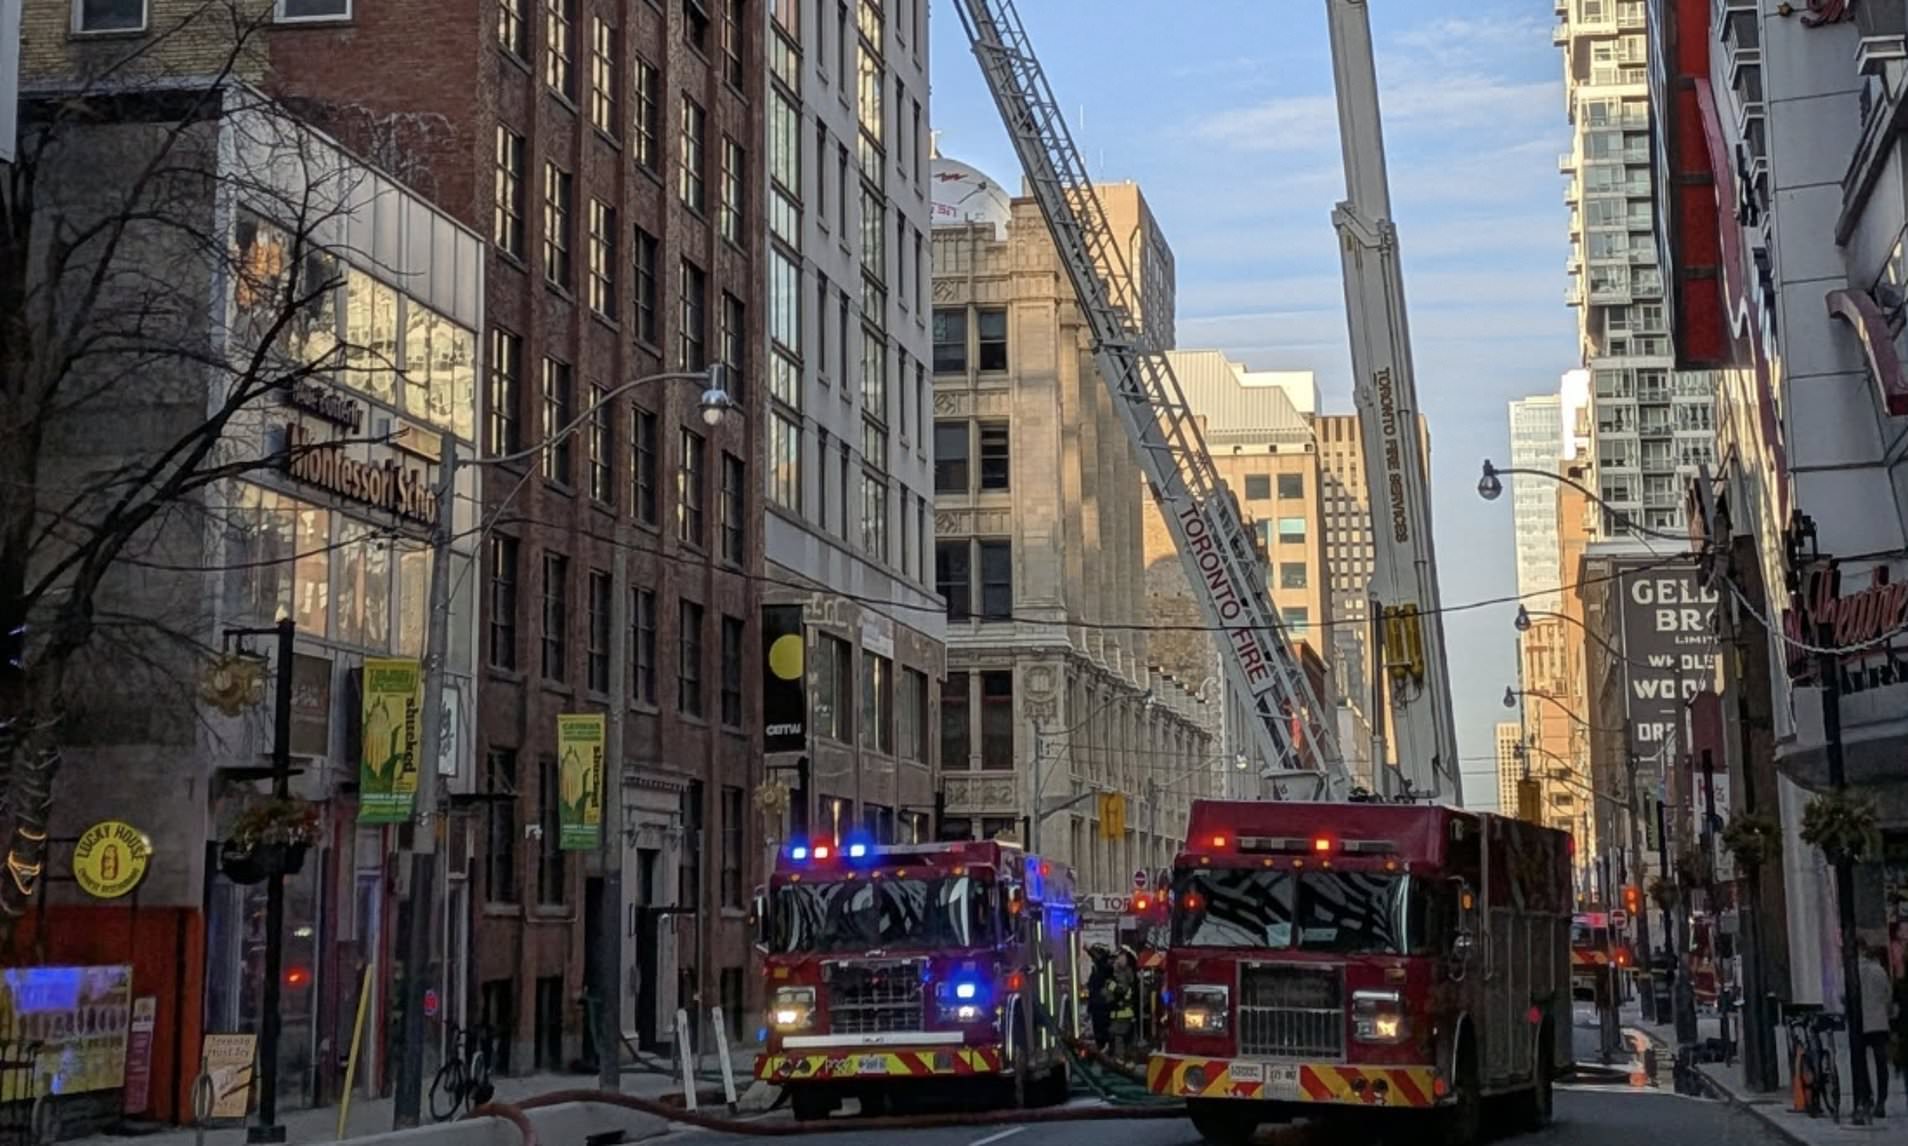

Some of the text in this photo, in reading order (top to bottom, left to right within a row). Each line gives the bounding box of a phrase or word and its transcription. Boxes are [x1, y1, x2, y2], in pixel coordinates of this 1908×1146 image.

[1180, 502, 1270, 686] TORONTO FIRE
[403, 697, 419, 773] shucked
[76, 824, 145, 861] LUCKY HOUSE
